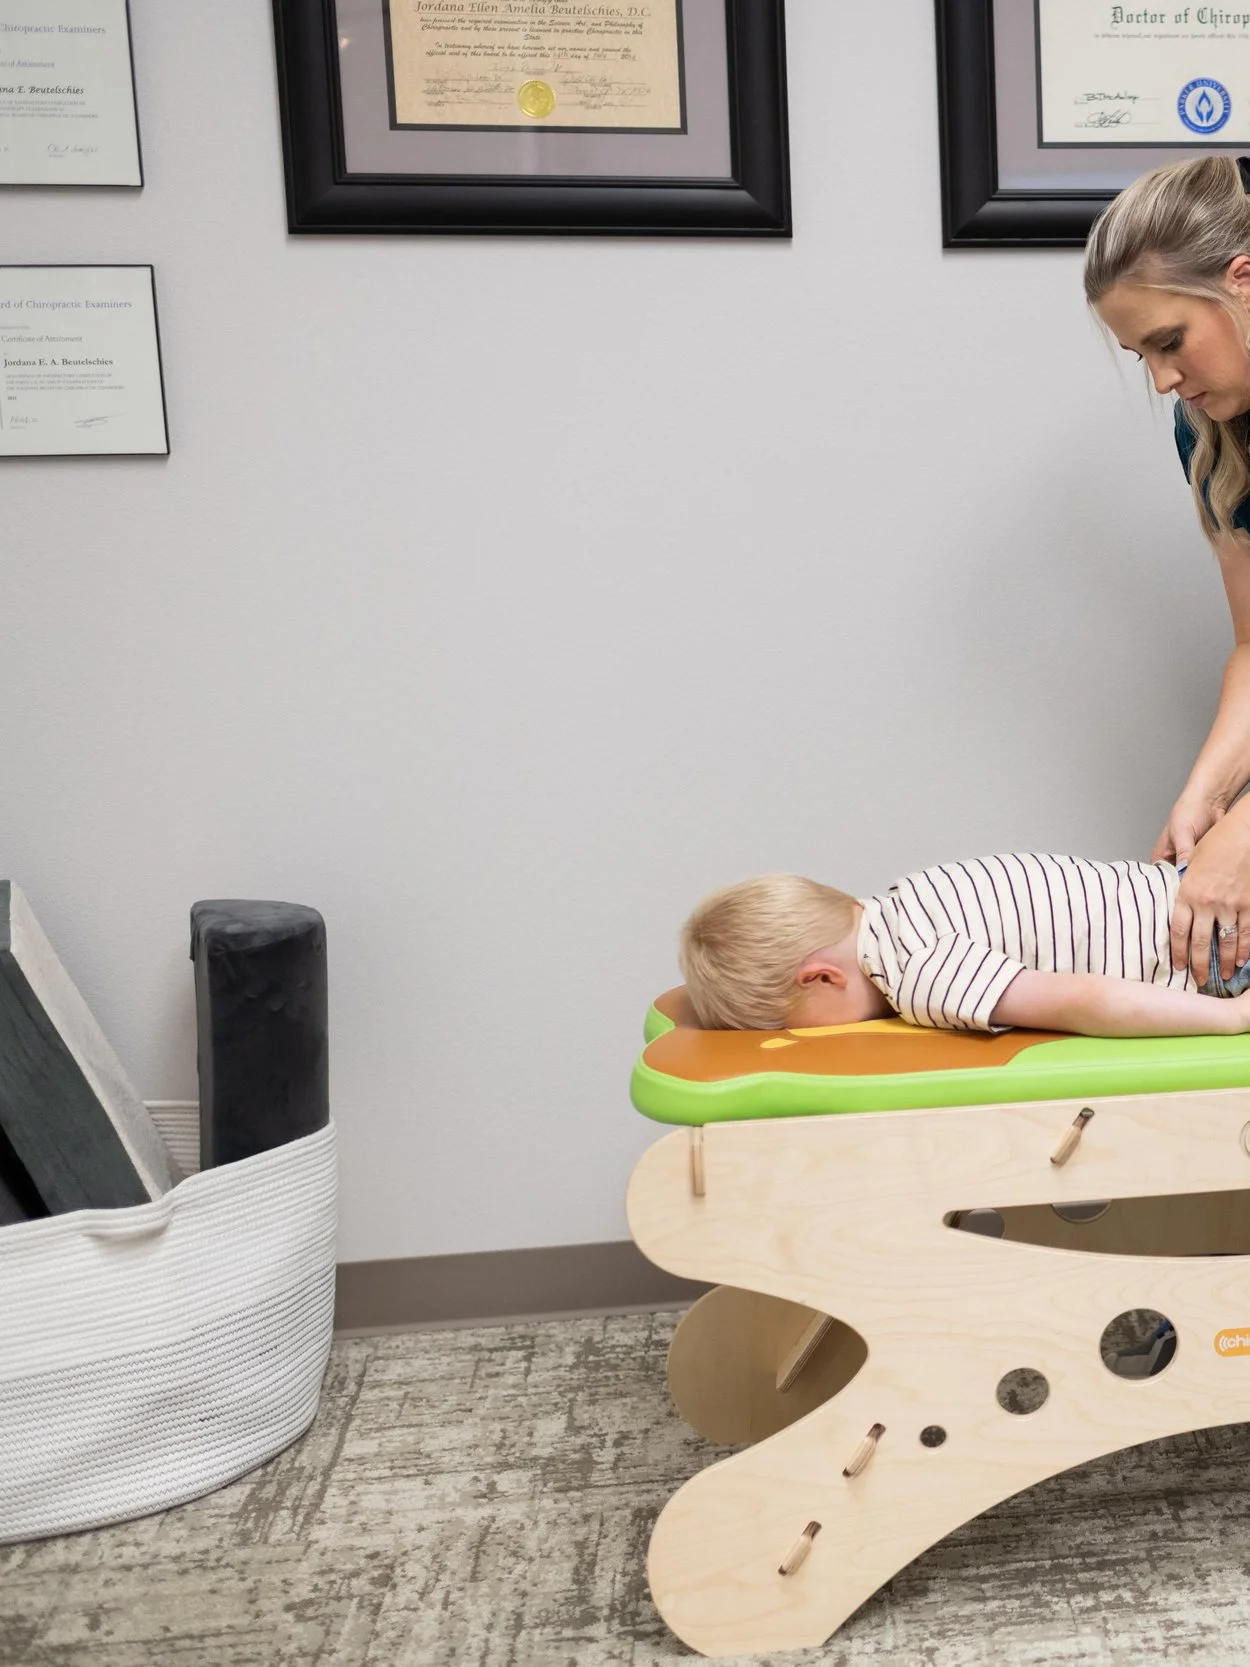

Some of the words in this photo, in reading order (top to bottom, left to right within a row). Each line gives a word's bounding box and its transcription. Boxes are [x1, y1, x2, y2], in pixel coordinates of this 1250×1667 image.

[415, 0, 465, 13] Jordana
[469, 2, 498, 13] Ellen
[502, 2, 546, 14] Amelia
[550, 4, 624, 18] Beutelschies,
[627, 6, 652, 17] D.C.
[1110, 6, 1165, 29] Doctor
[1174, 7, 1190, 24] of
[58, 24, 107, 34] Examiners
[586, 27, 622, 36] Chiropractic
[29, 85, 84, 95] Beutelschies
[13, 299, 24, 309] of
[25, 300, 82, 311] Chiropractic
[85, 300, 132, 310] Examiners
[4, 358, 37, 369] Jordana
[50, 358, 60, 366] A.
[61, 358, 114, 367] Beutelschies
